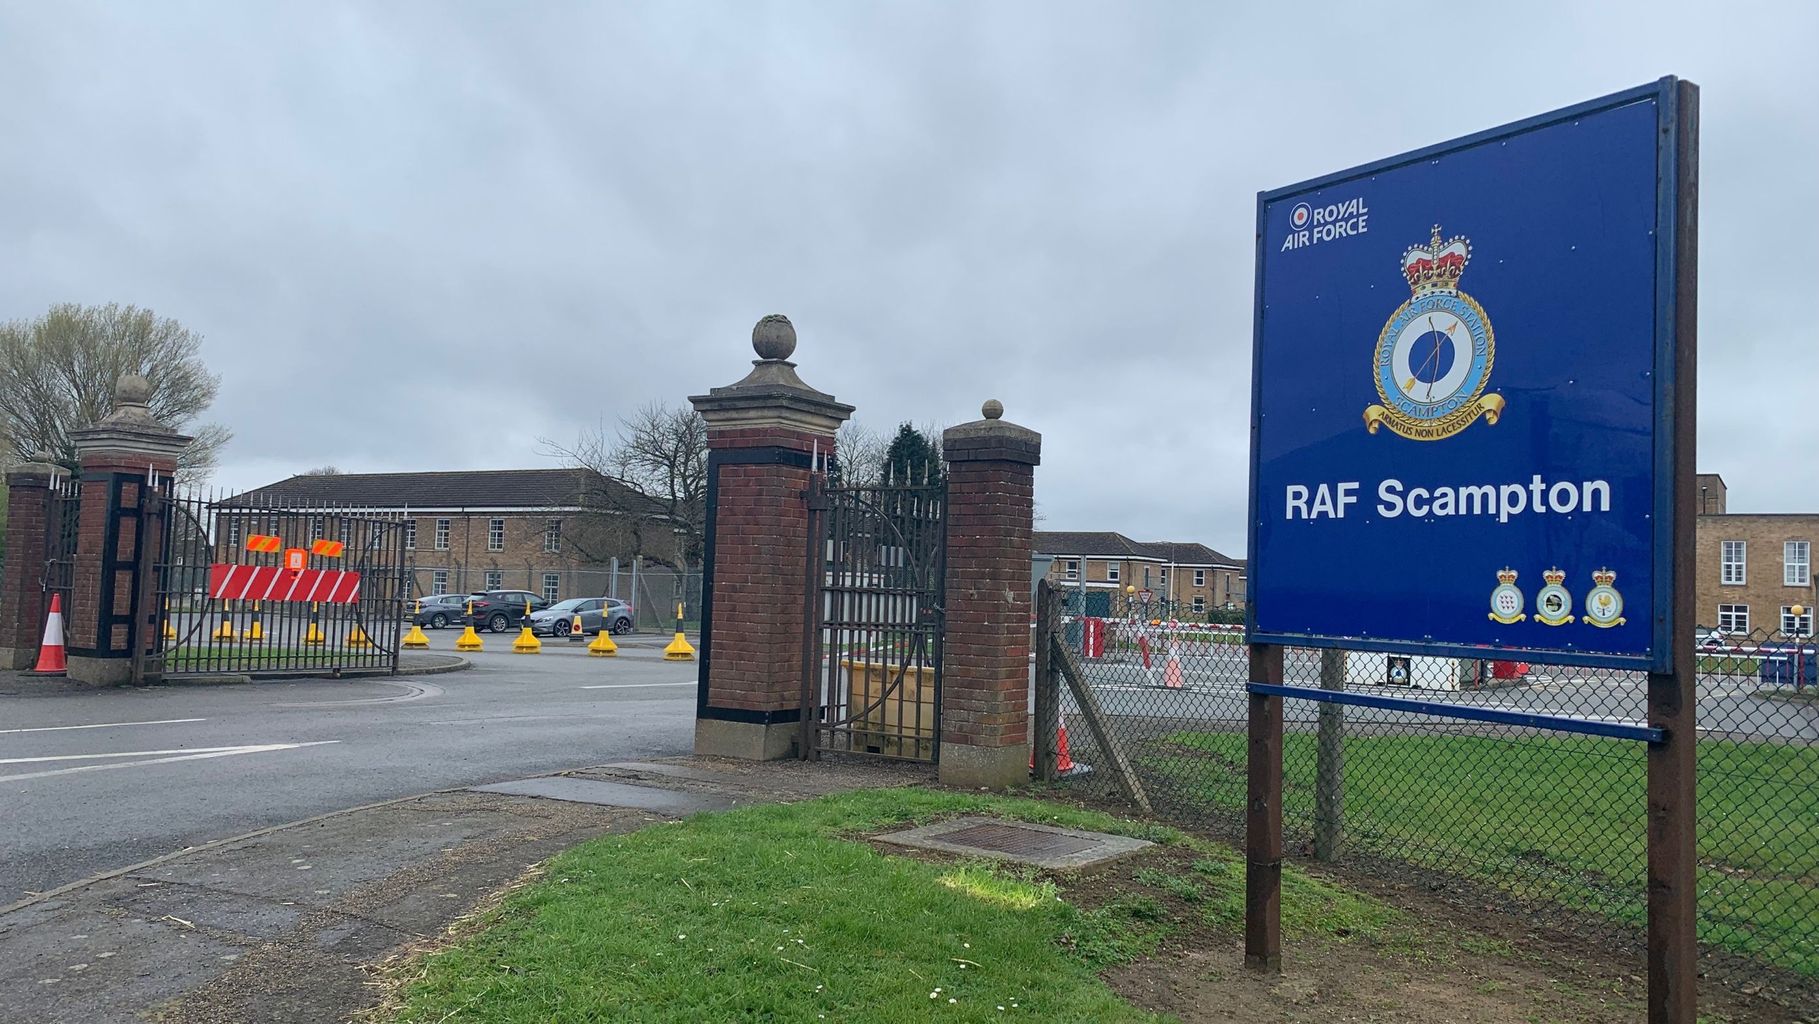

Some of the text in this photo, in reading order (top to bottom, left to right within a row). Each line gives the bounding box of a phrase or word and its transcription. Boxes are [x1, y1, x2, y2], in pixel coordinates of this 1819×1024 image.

[1313, 197, 1369, 226] ROYAL
[1280, 215, 1369, 253] AIR FORCE
[1380, 298, 1487, 368] ROYAL AIR FORCE STATION
[1378, 402, 1486, 439] ARMATUS NON LACESSITUR
[1395, 391, 1470, 418] SCAMPTON
[1285, 474, 1611, 523] RAF Scampton
